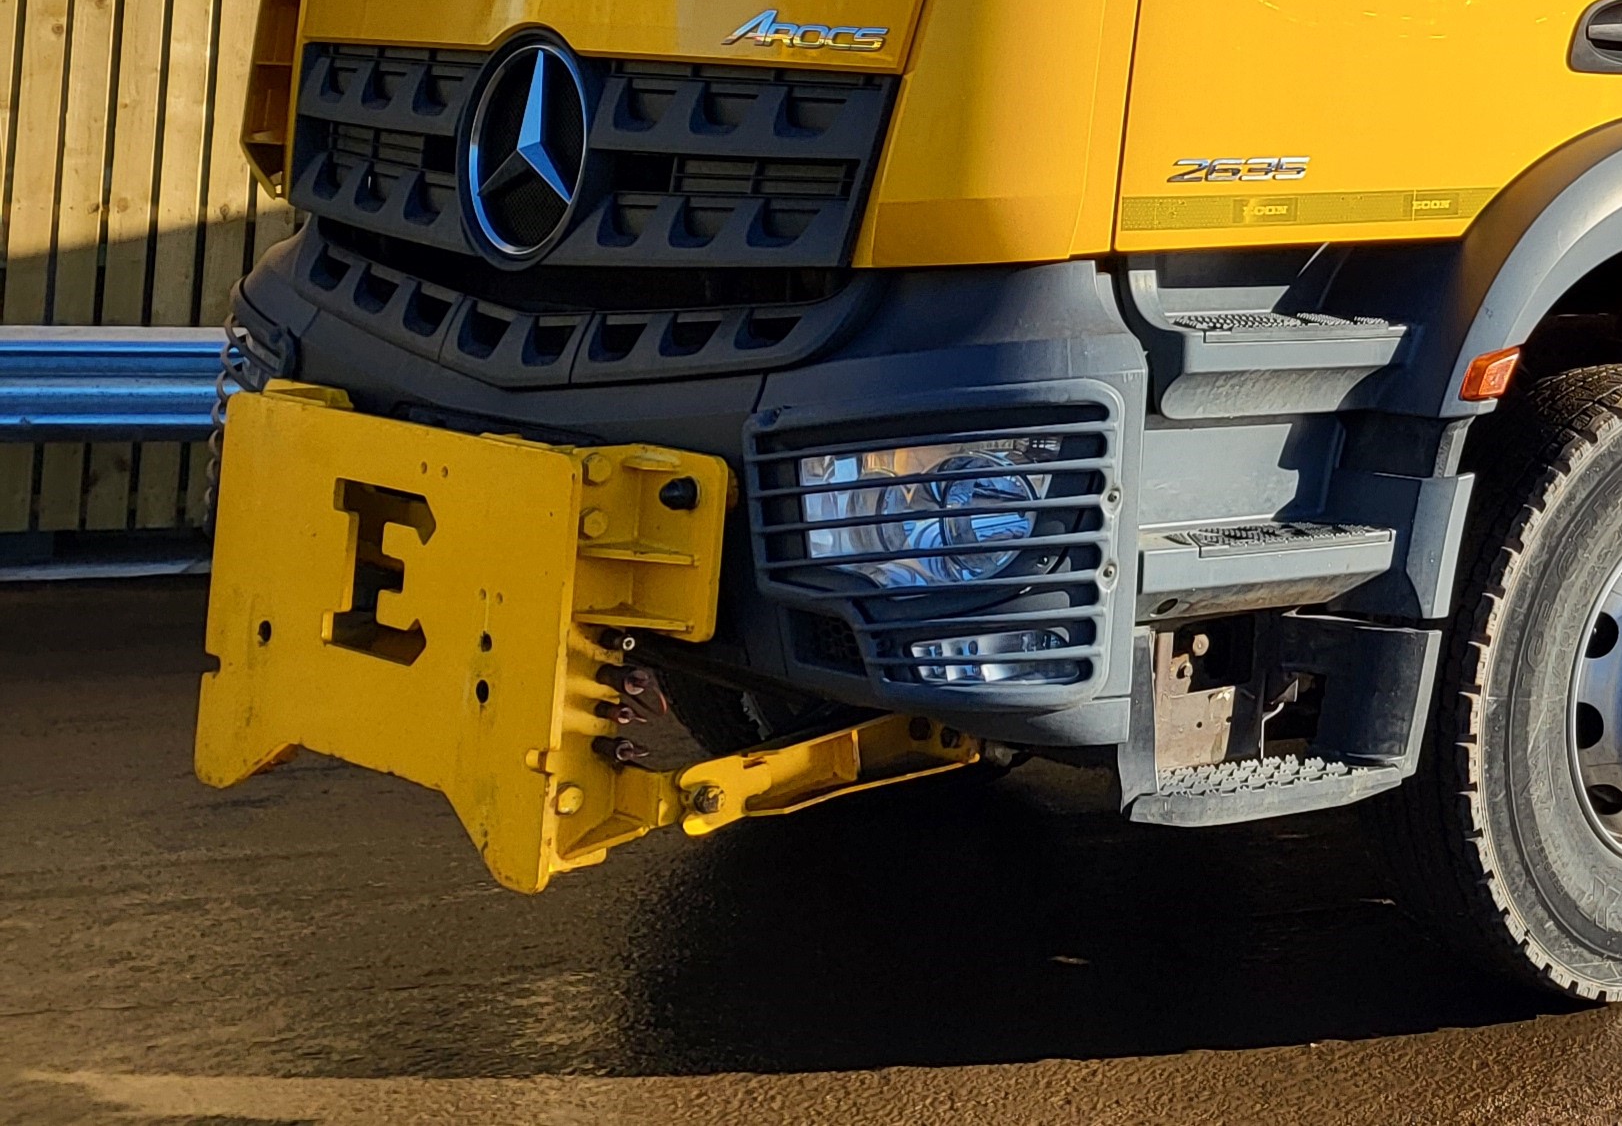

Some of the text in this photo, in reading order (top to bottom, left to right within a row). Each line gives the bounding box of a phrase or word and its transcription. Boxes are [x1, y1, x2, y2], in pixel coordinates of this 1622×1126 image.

[1167, 155, 1311, 184] 2635
[1412, 198, 1452, 211] ECON
[322, 477, 437, 681] E
